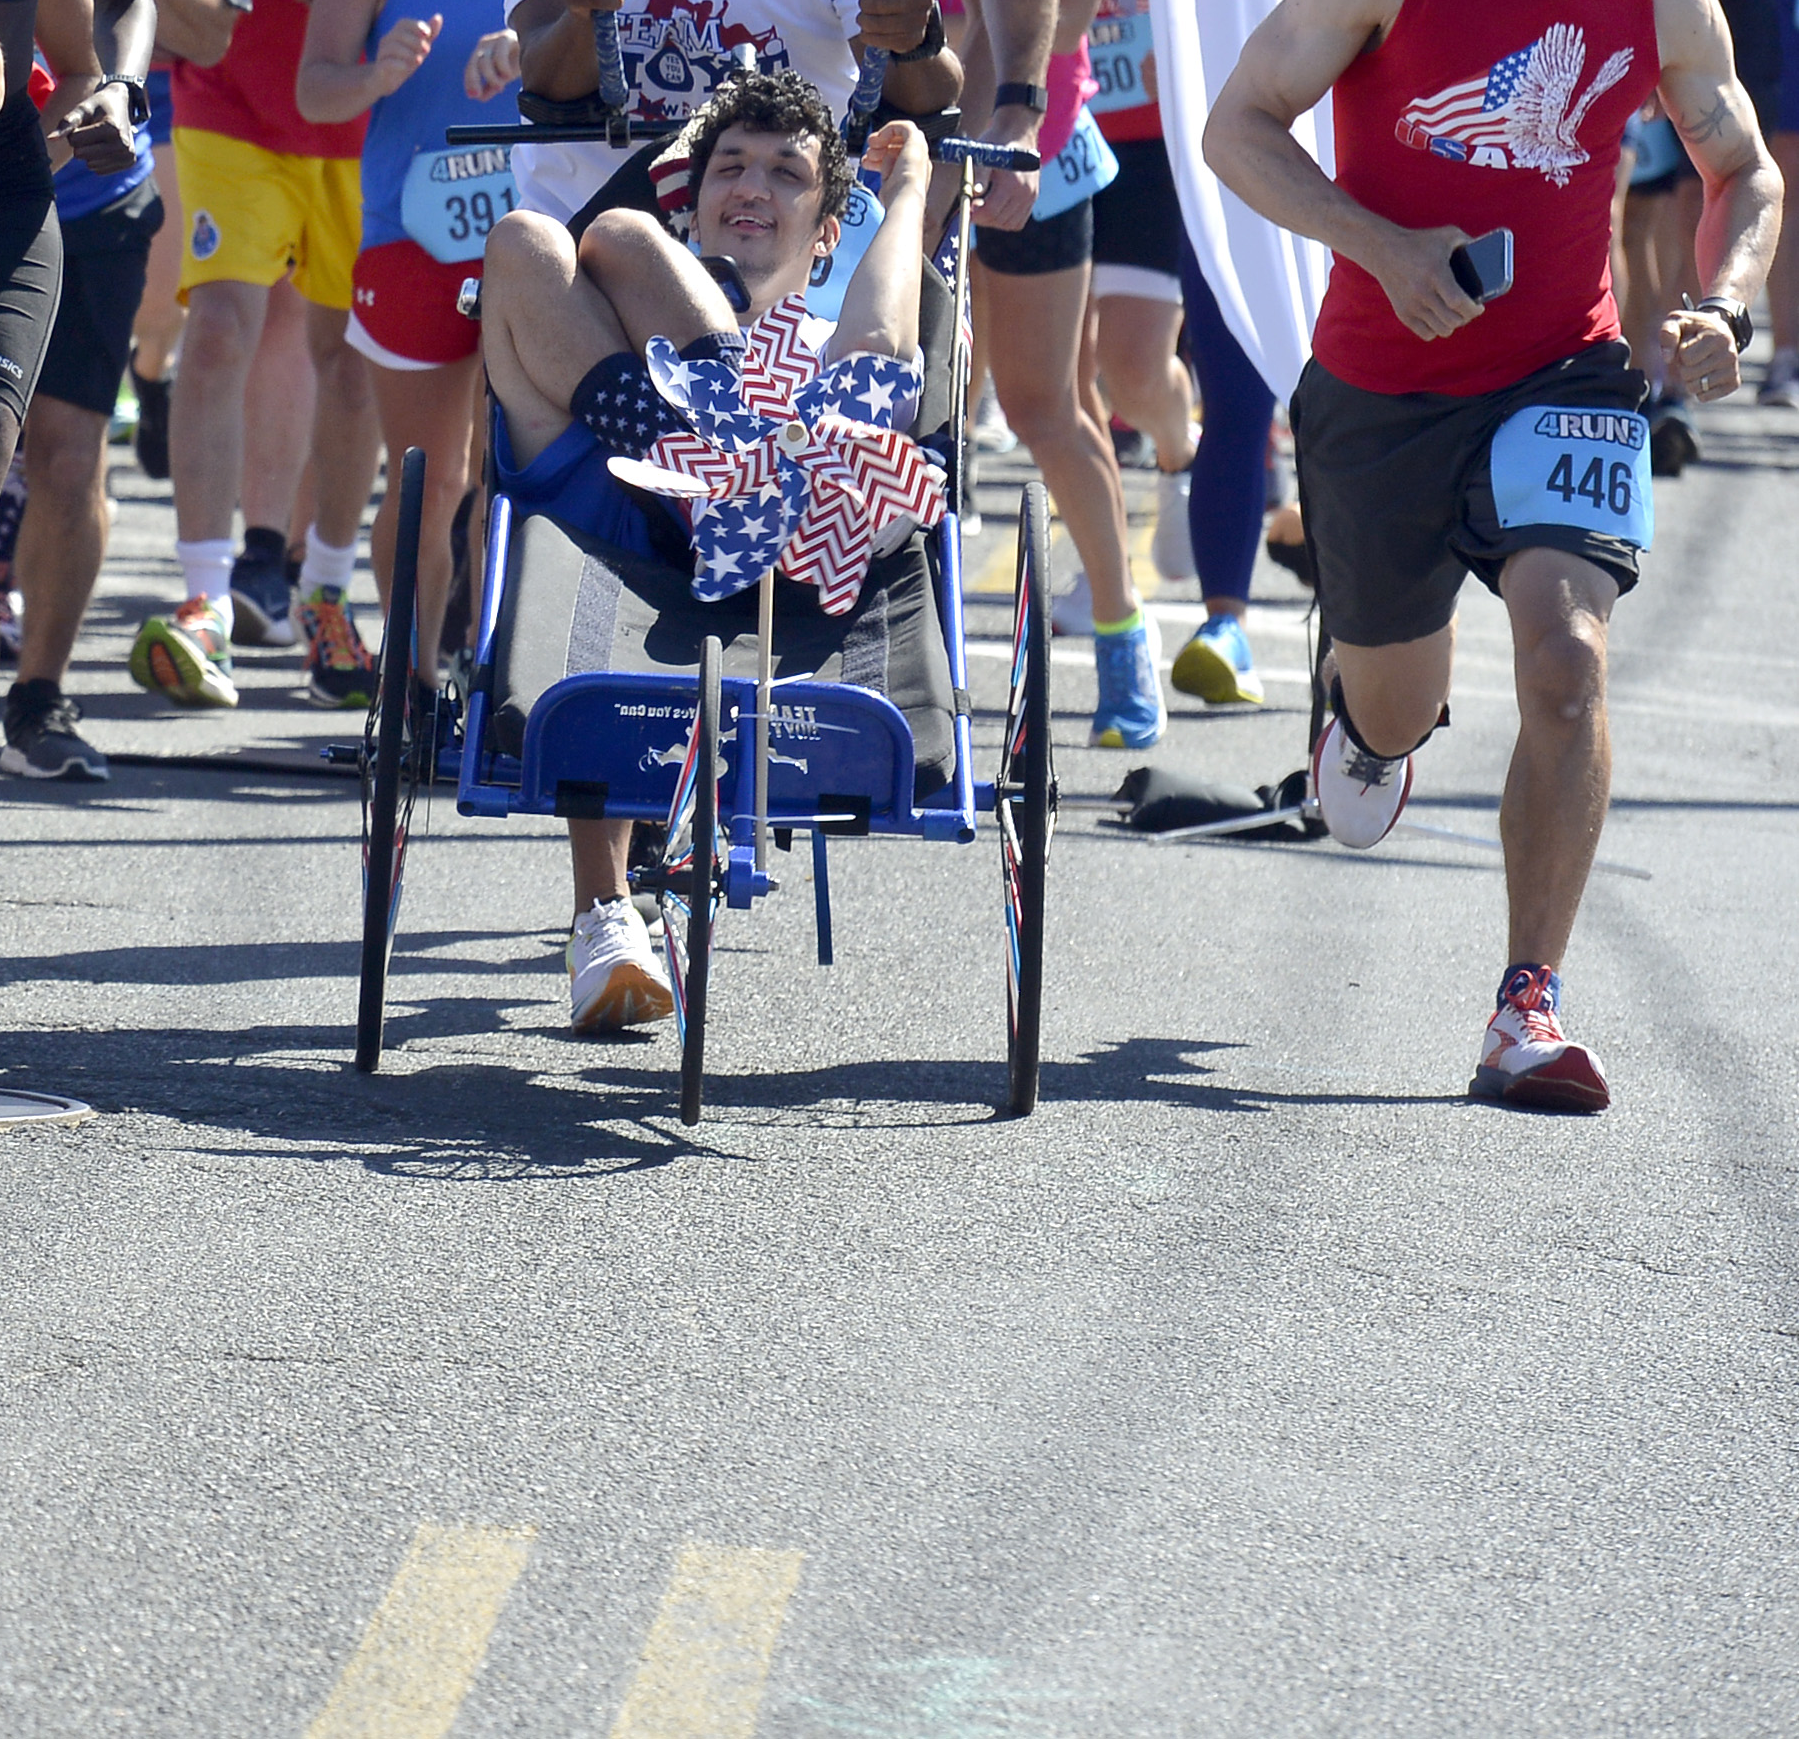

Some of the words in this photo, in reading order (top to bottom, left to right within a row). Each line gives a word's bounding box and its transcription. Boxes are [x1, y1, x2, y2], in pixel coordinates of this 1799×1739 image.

[665, 56, 680, 65] YES
[665, 64, 681, 73] YOU
[665, 73, 682, 82] CAN
[1093, 55, 1136, 97] 50
[1395, 117, 1509, 170] USA
[445, 187, 515, 241] 391
[1534, 412, 1646, 451] 4RUN3
[1546, 453, 1633, 516] 446
